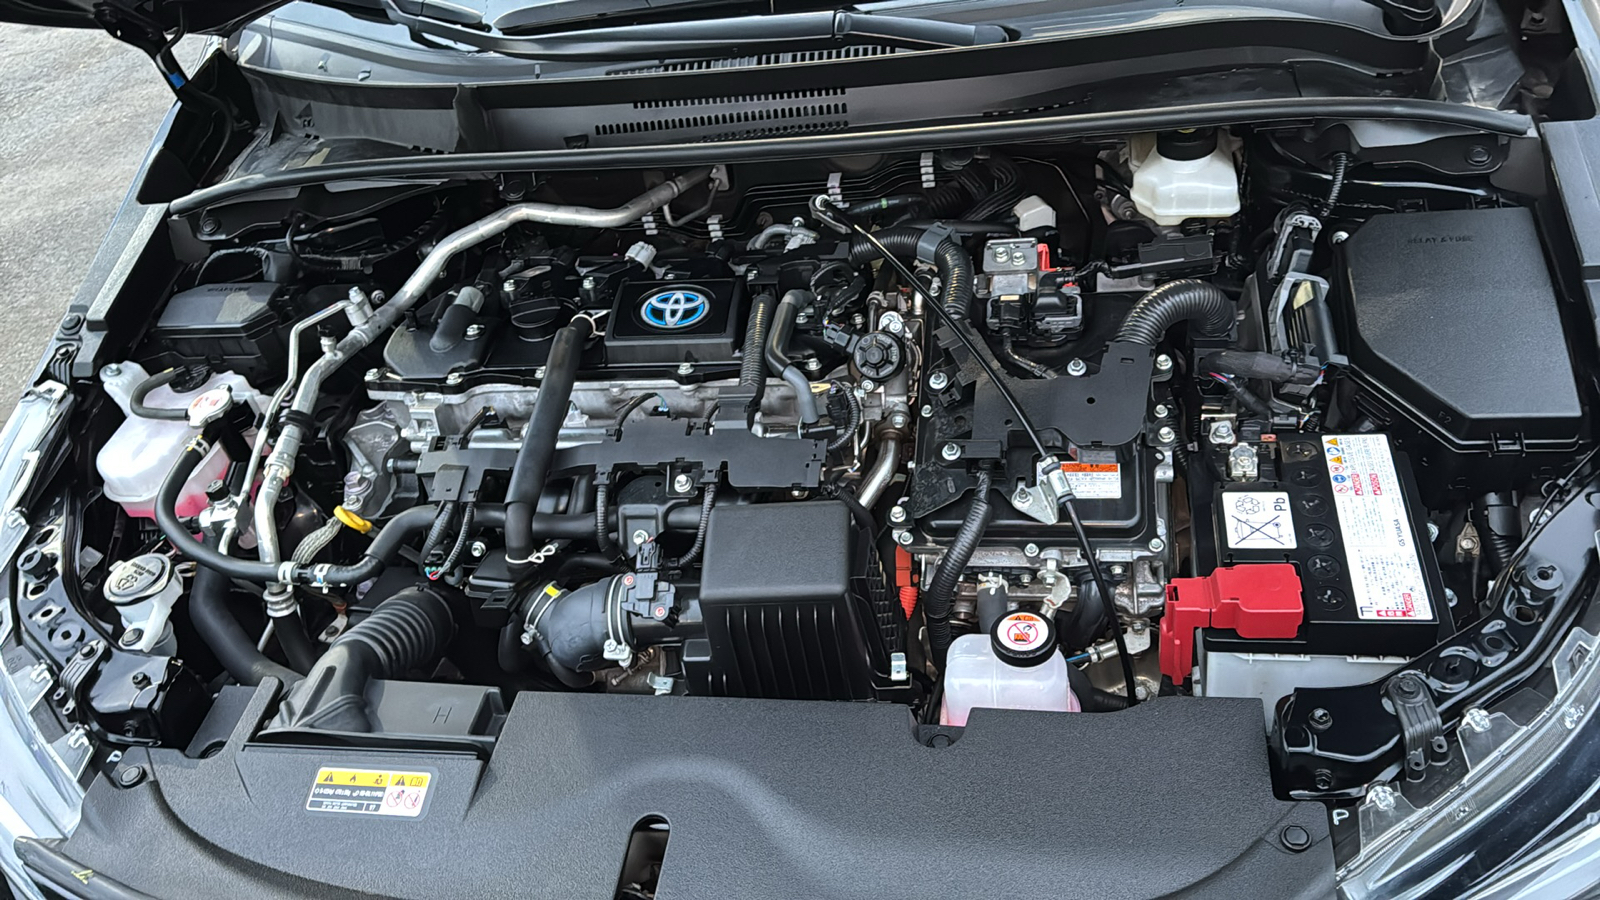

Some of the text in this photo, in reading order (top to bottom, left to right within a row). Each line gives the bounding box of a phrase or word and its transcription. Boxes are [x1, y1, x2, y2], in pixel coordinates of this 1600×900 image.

[1273, 497, 1287, 512] Pb
[1393, 518, 1406, 547] GS YUASA
[105, 750, 122, 763] P
[1332, 809, 1349, 825] P
